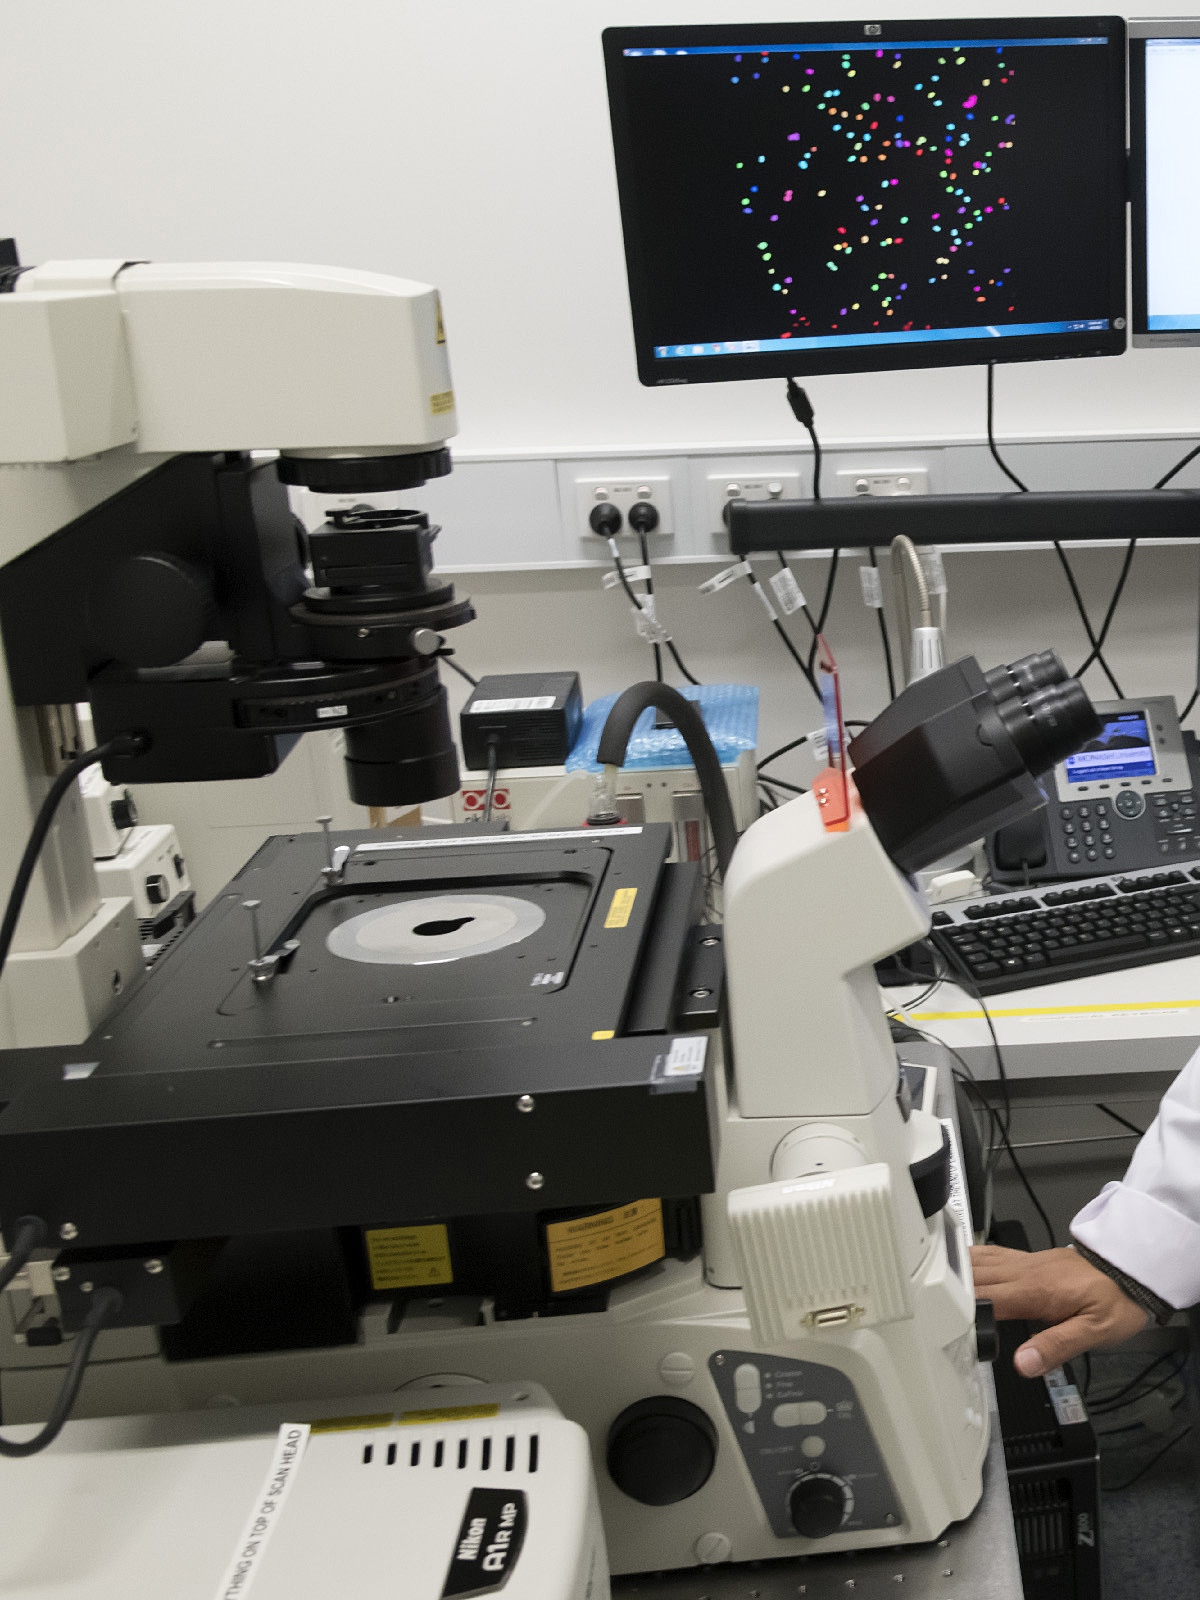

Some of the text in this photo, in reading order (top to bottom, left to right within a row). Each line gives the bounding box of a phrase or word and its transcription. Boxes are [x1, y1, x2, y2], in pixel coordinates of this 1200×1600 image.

[280, 1429, 302, 1465] HEAD
[267, 1467, 291, 1497] SCAN
[260, 1500, 277, 1514] OF
[498, 1502, 518, 1528] MP
[249, 1516, 268, 1538] TOP
[456, 1517, 487, 1560] Nikon
[241, 1540, 261, 1558] ON
